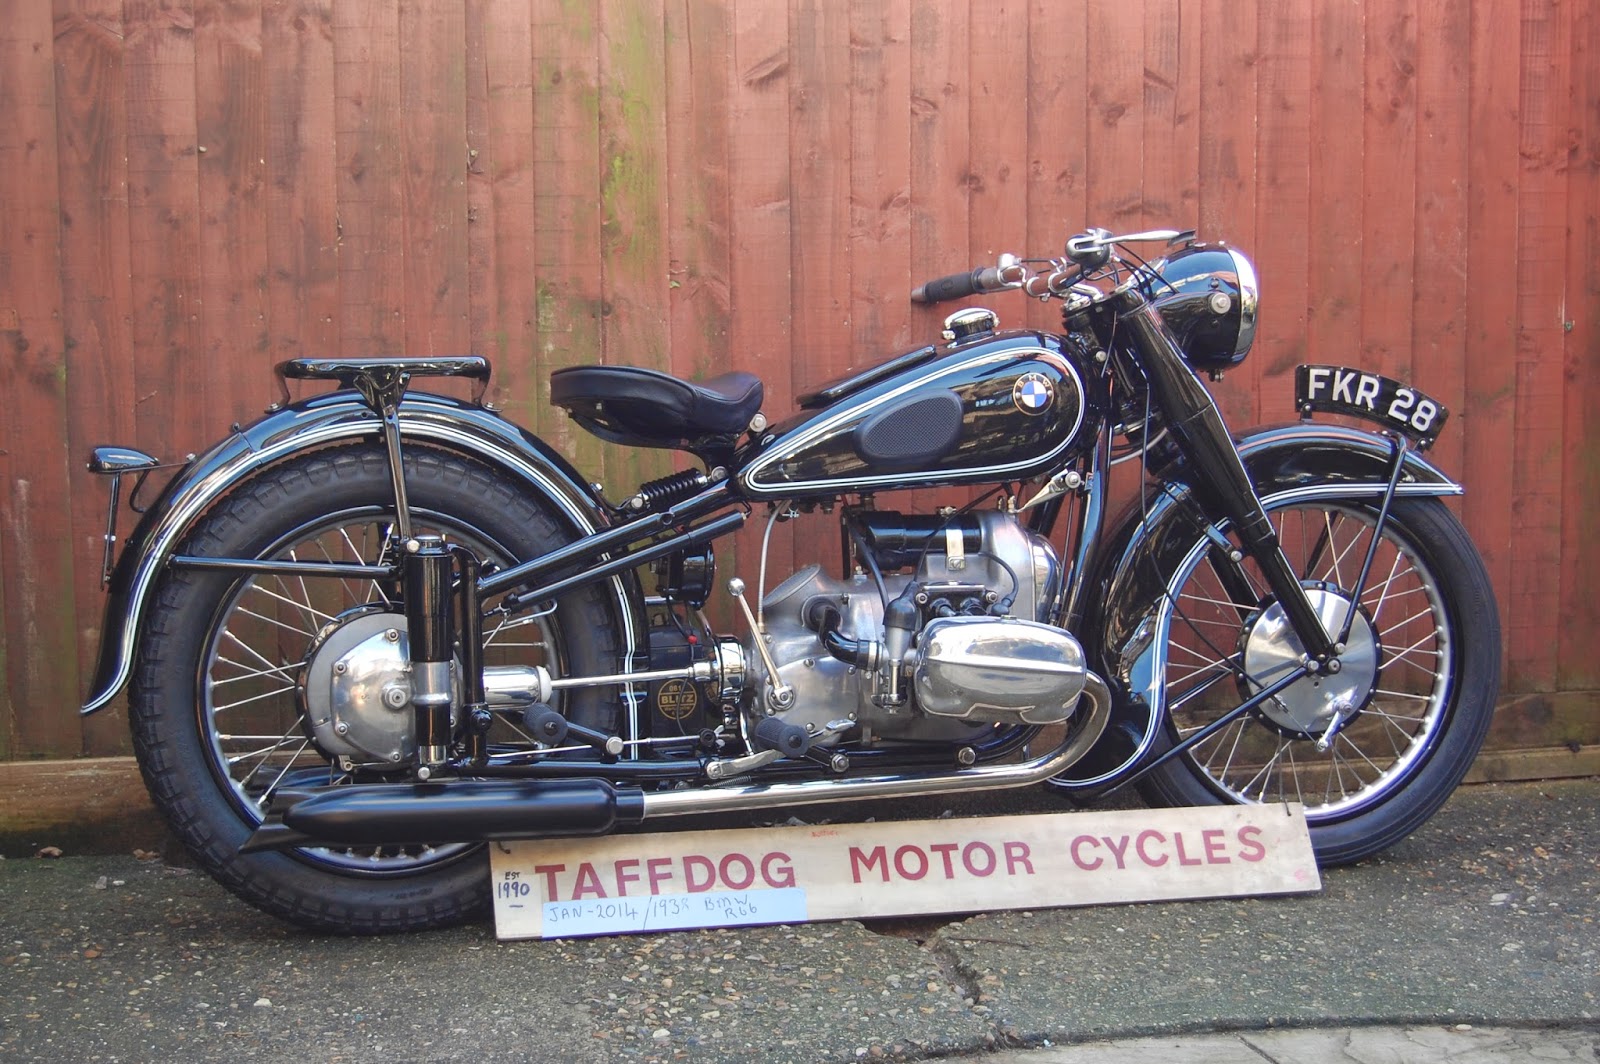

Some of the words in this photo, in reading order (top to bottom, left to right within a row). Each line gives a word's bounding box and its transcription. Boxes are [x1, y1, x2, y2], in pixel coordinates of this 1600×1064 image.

[1308, 368, 1380, 410] FKR
[1387, 388, 1437, 432] 28
[661, 694, 694, 704] BLITZ
[534, 851, 797, 901] TAFFDOG
[848, 841, 1035, 884] MOTOR
[1070, 825, 1267, 871] CYCLES
[504, 871, 521, 880] EST
[498, 881, 531, 899] 1990
